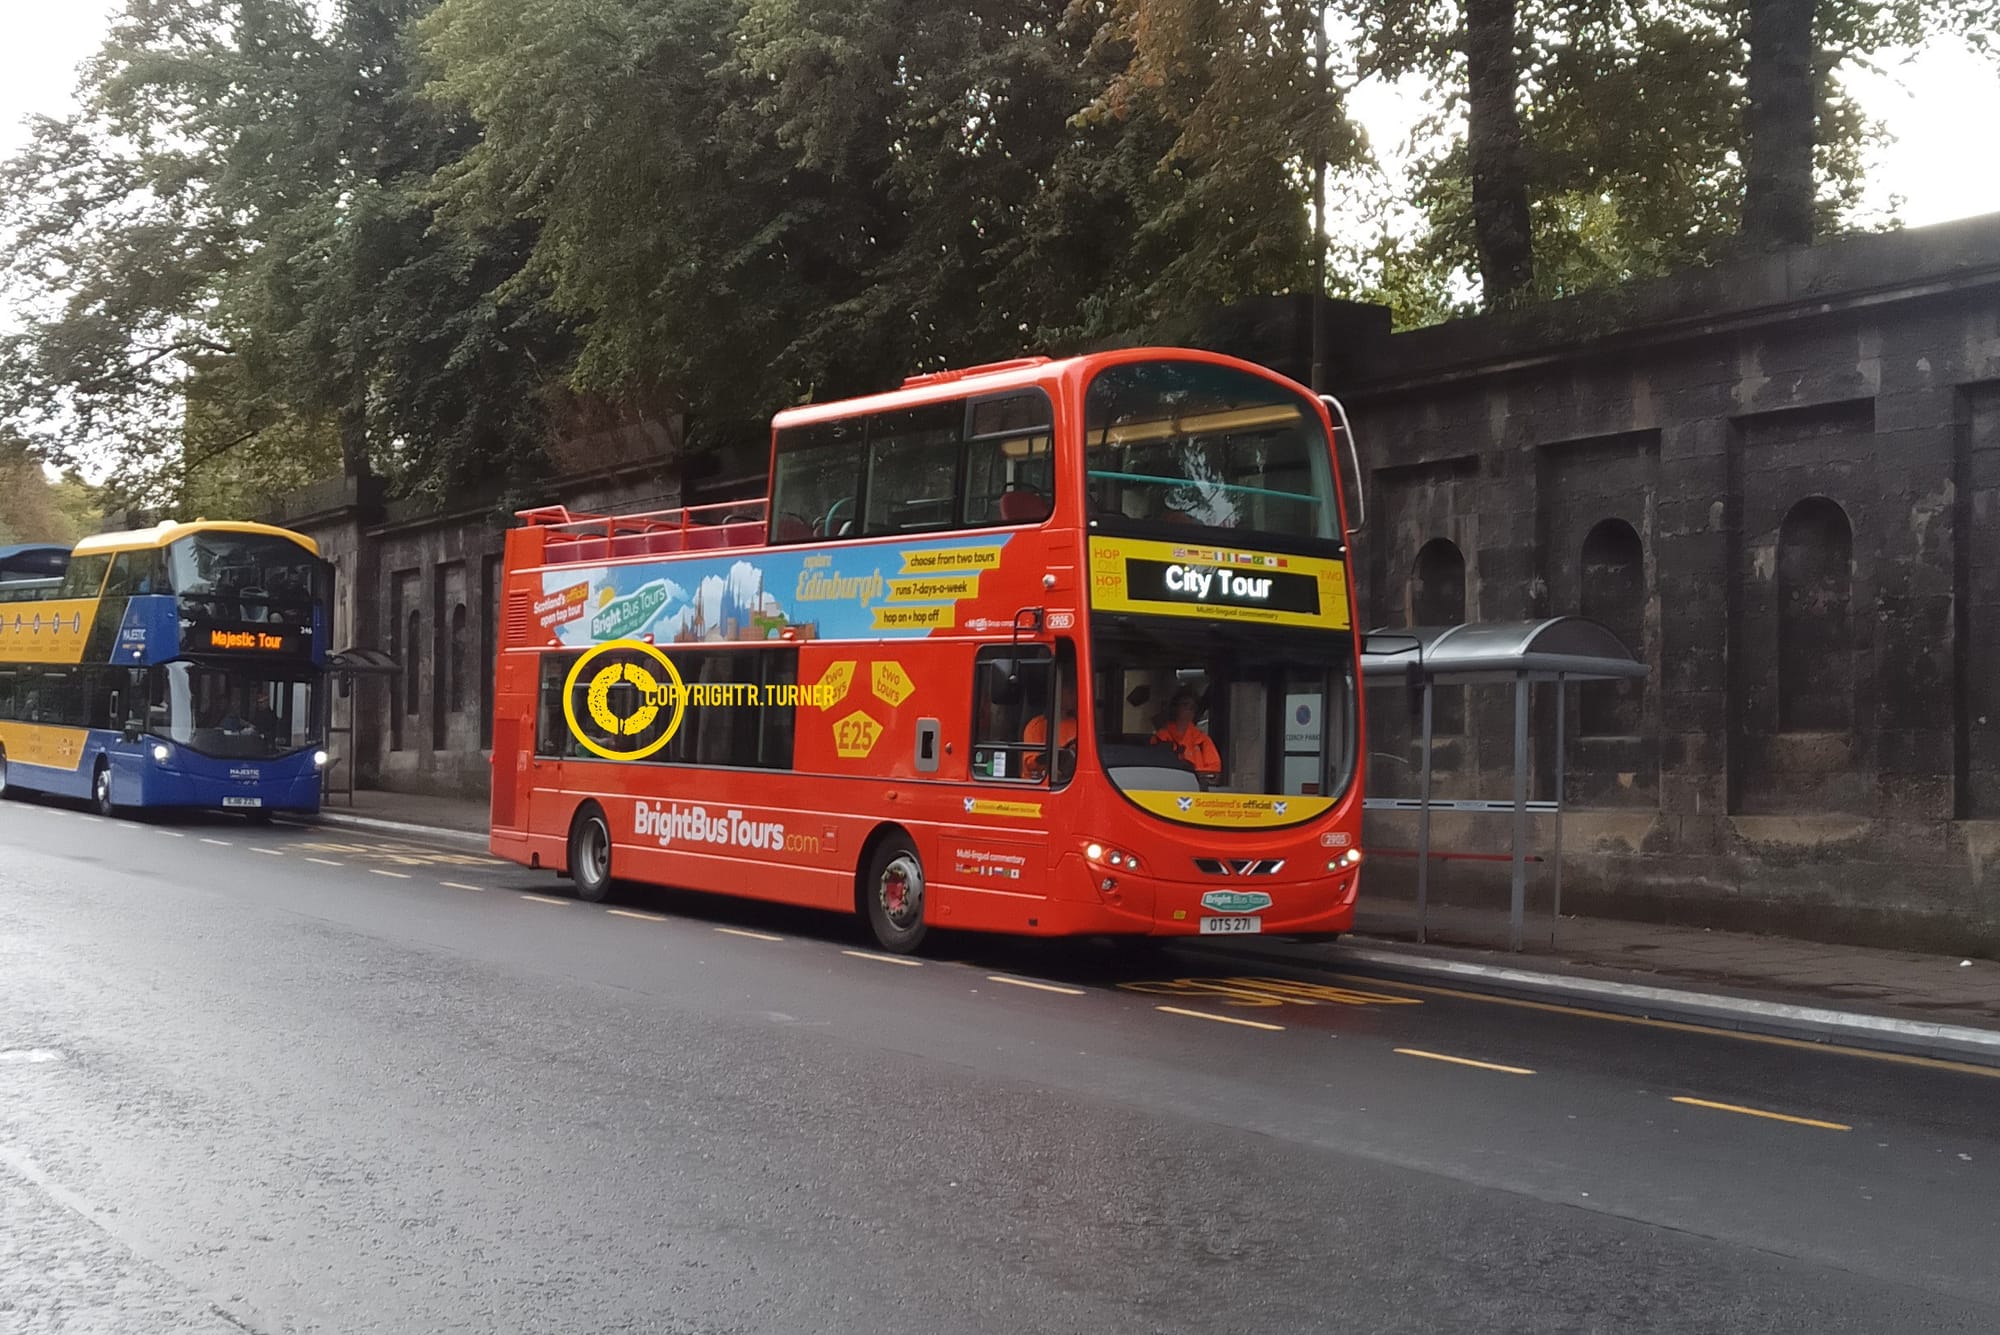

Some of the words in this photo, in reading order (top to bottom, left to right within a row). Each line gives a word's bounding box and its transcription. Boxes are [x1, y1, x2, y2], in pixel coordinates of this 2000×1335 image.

[910, 554, 936, 567] choose
[937, 552, 955, 566] from
[957, 552, 973, 564] two
[974, 551, 995, 562] tours
[1094, 548, 1120, 559] HOP
[796, 567, 883, 608] Edinburgh
[1166, 565, 1212, 598] City
[1218, 569, 1273, 598] Tour
[895, 586, 912, 596] runs
[593, 608, 621, 635] Bright
[622, 602, 639, 621] Bus
[639, 587, 665, 610] Tours
[883, 611, 897, 625] hop
[898, 614, 907, 622] on
[913, 610, 927, 624] hop
[928, 609, 940, 622] off
[211, 630, 255, 649] Majestic
[258, 632, 282, 649] Tour
[825, 667, 843, 684] two
[881, 664, 900, 686] two
[876, 678, 900, 702] tours
[838, 720, 872, 751] £25
[229, 768, 260, 776] MAJESTIC
[1210, 918, 1231, 931] OTS
[1233, 918, 1251, 931] 271
